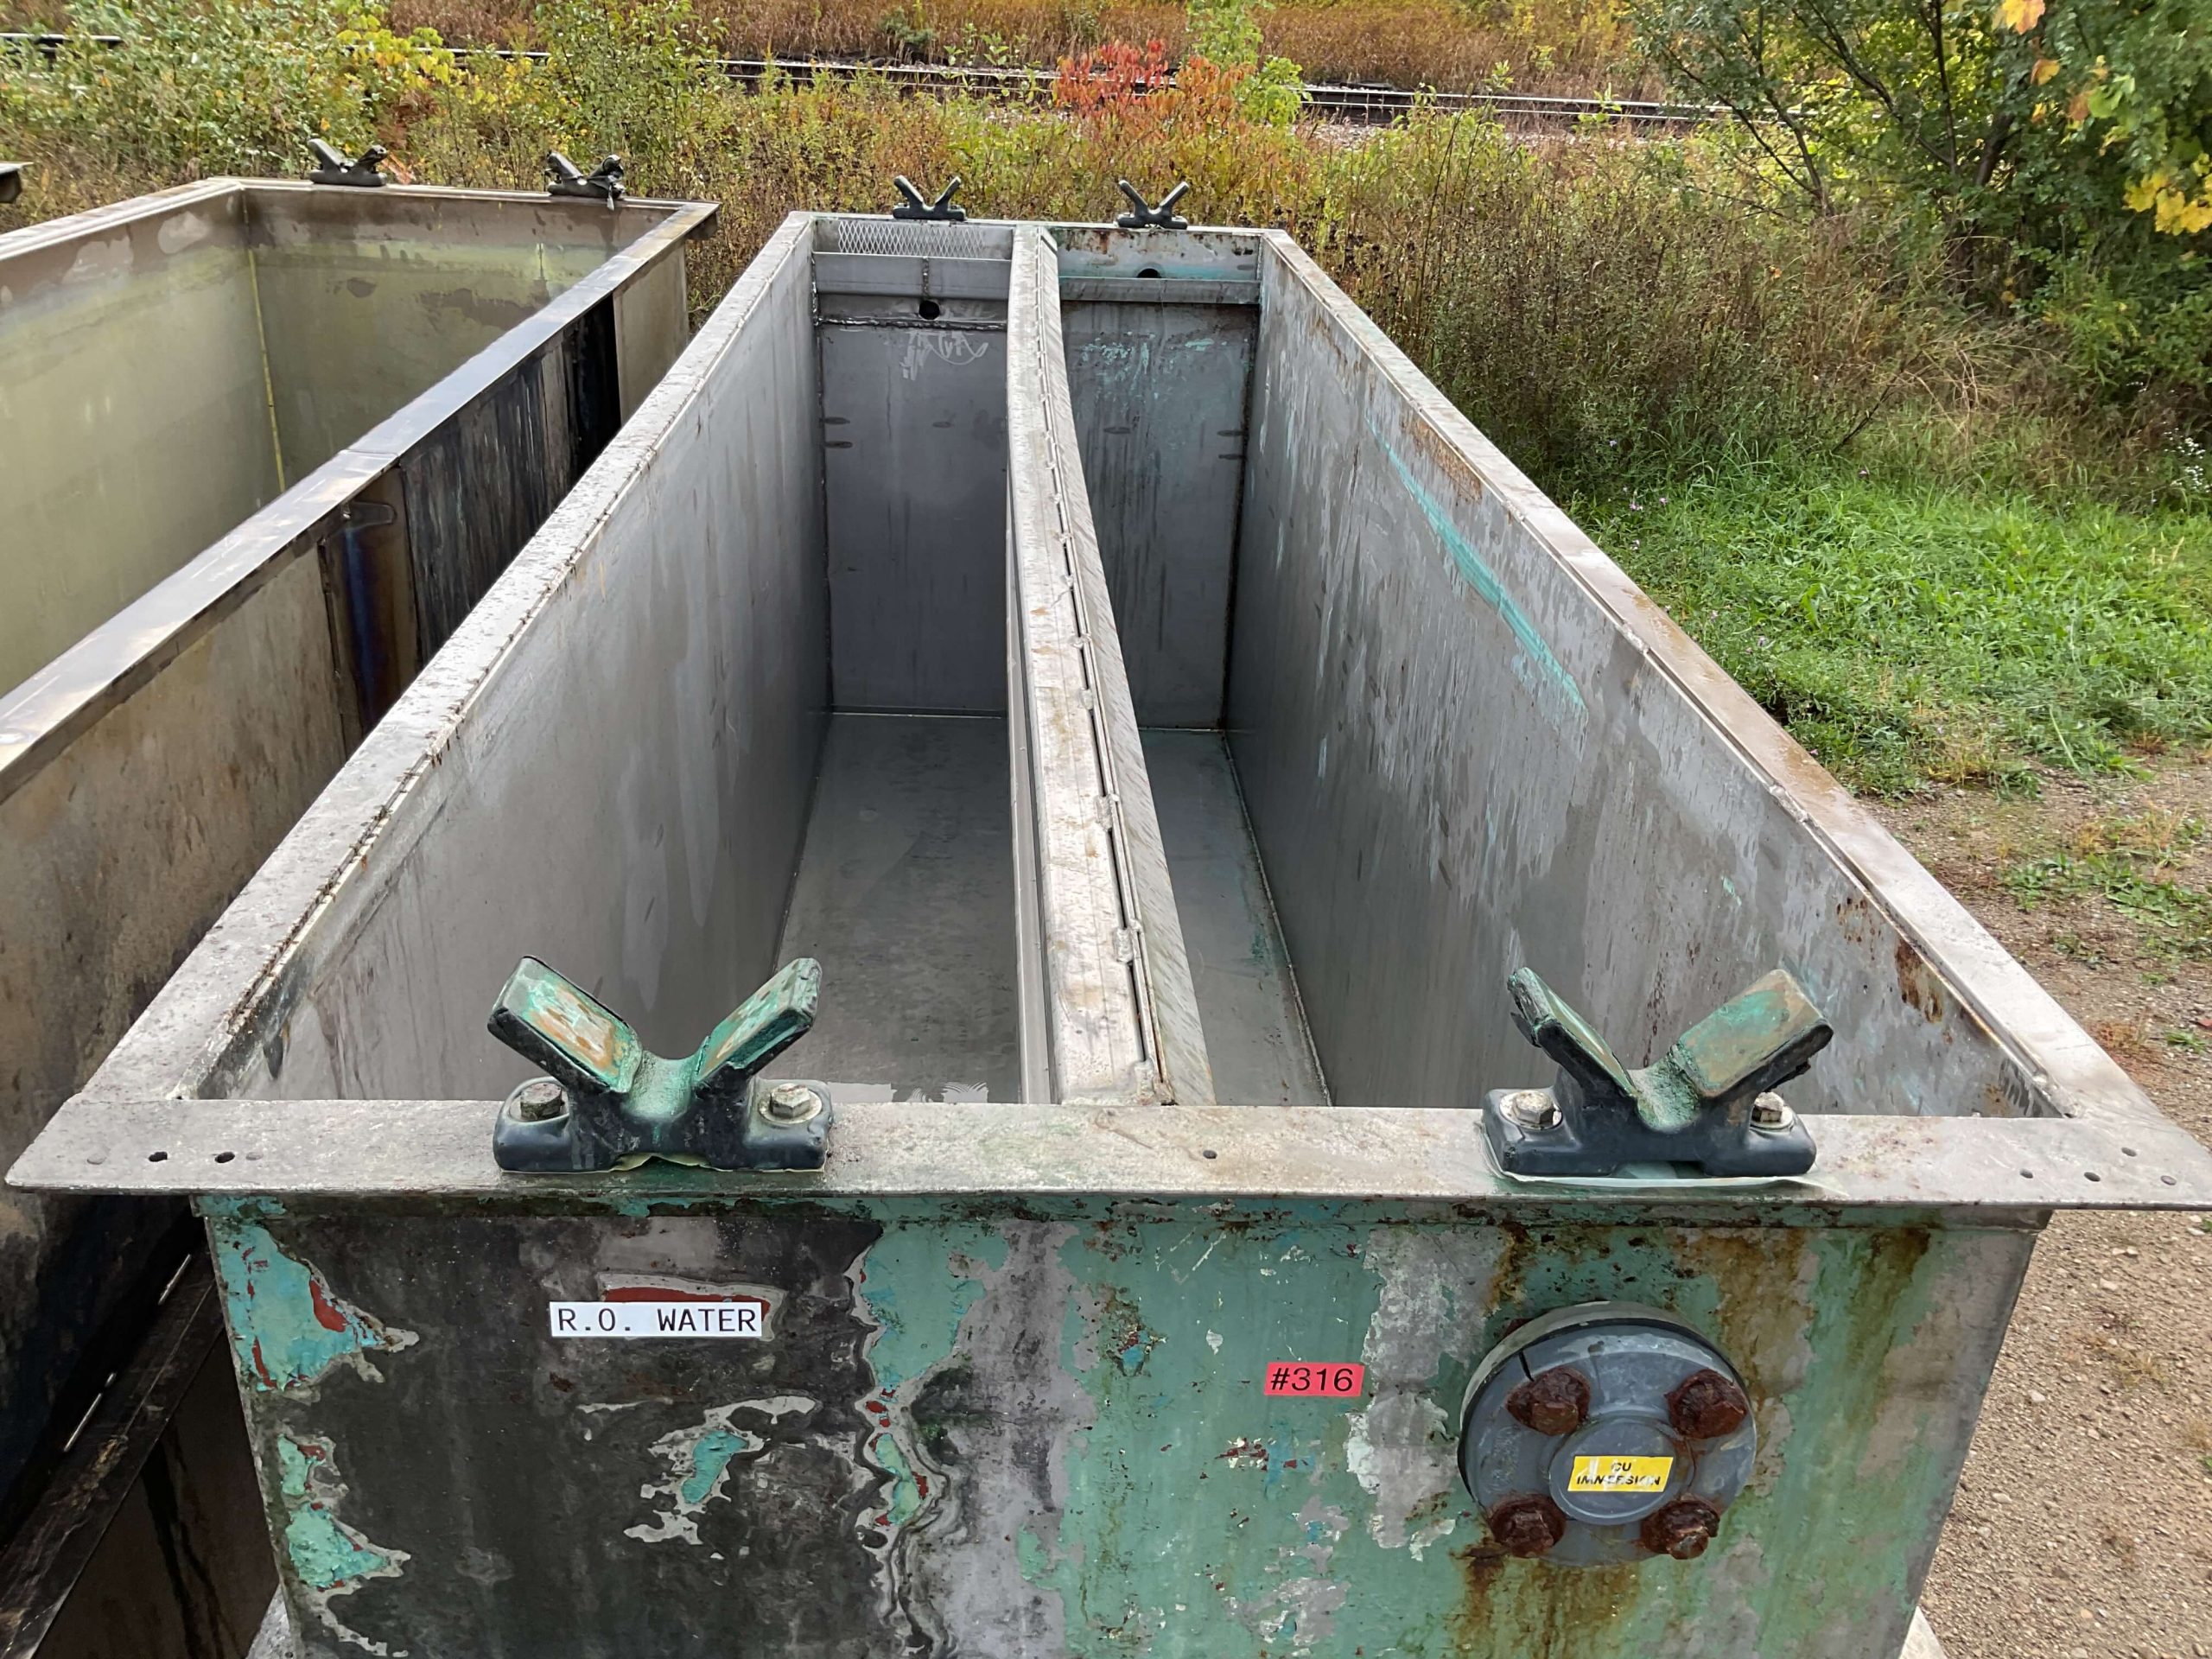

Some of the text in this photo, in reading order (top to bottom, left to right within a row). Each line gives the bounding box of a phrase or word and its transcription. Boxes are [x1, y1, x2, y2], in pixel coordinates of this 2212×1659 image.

[557, 1307, 757, 1332] R.O. WATER
[1270, 1366, 1354, 1392] #316
